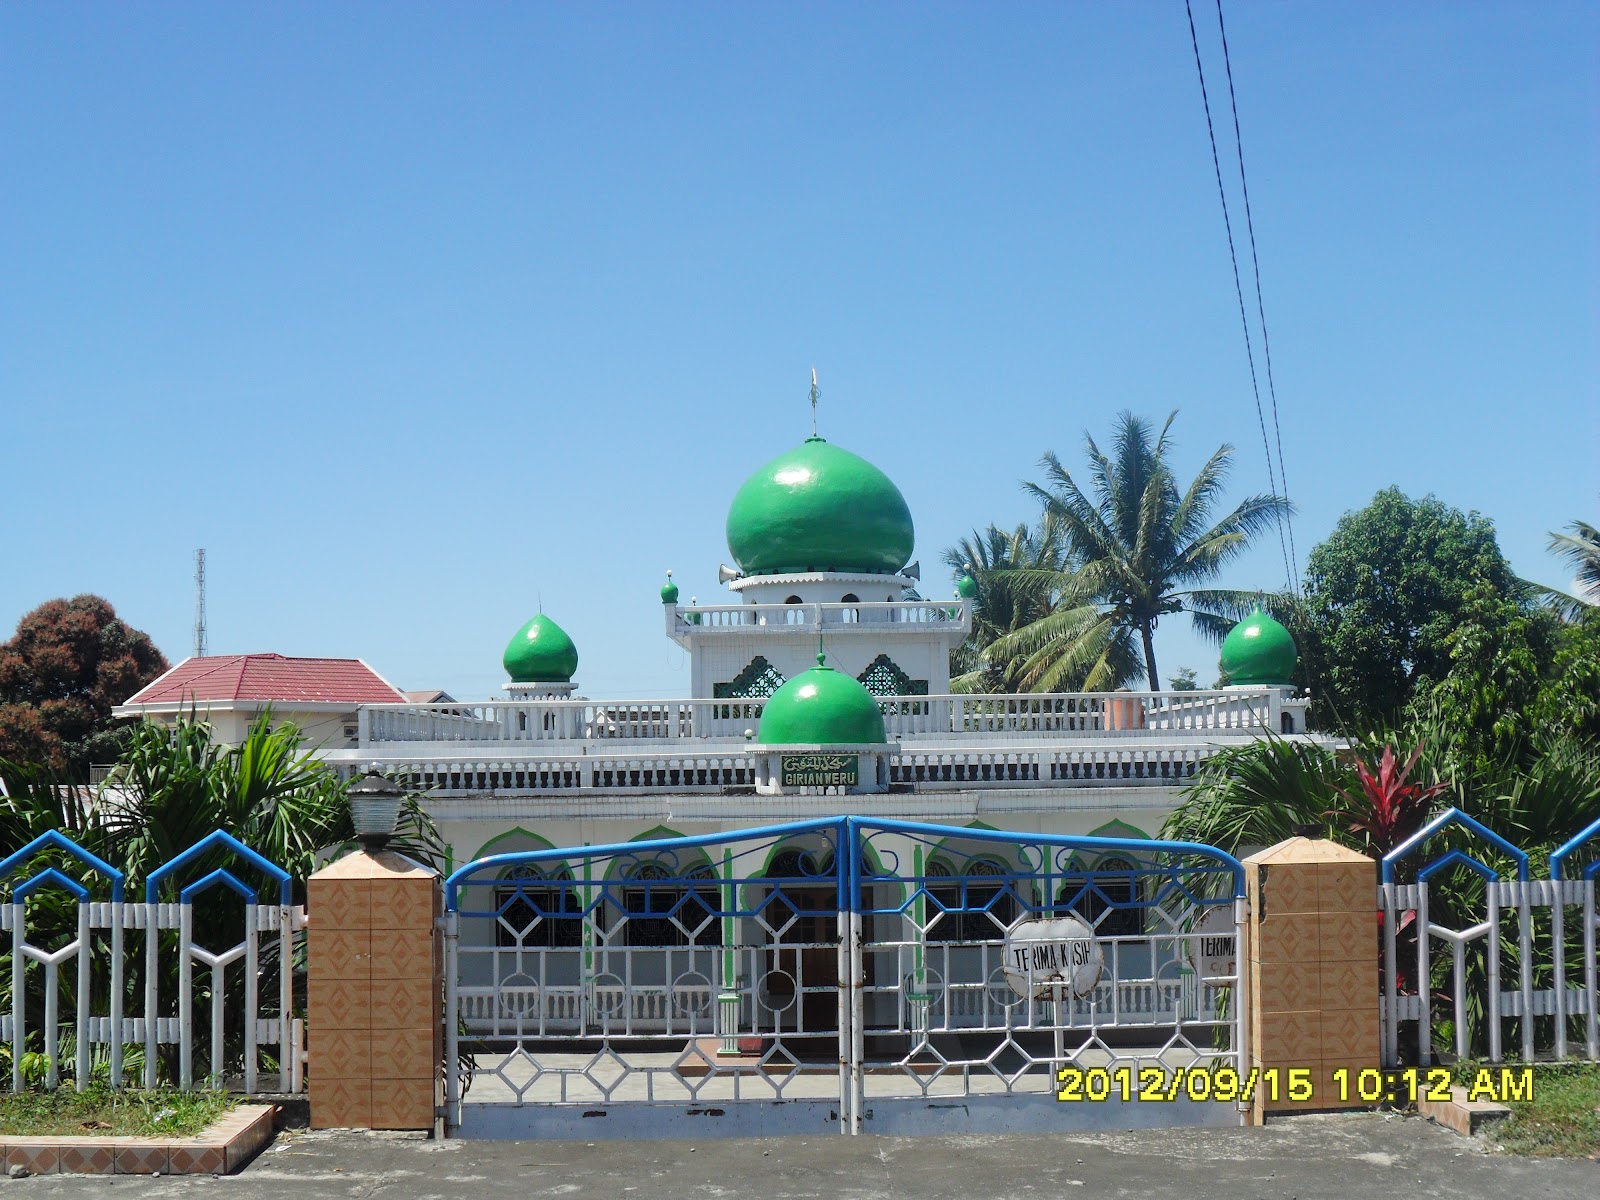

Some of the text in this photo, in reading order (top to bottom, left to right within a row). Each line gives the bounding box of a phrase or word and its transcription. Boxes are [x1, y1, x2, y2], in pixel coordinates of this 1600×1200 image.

[785, 772, 855, 785] GIRIAN WERU
[1060, 941, 1090, 967] KSIH
